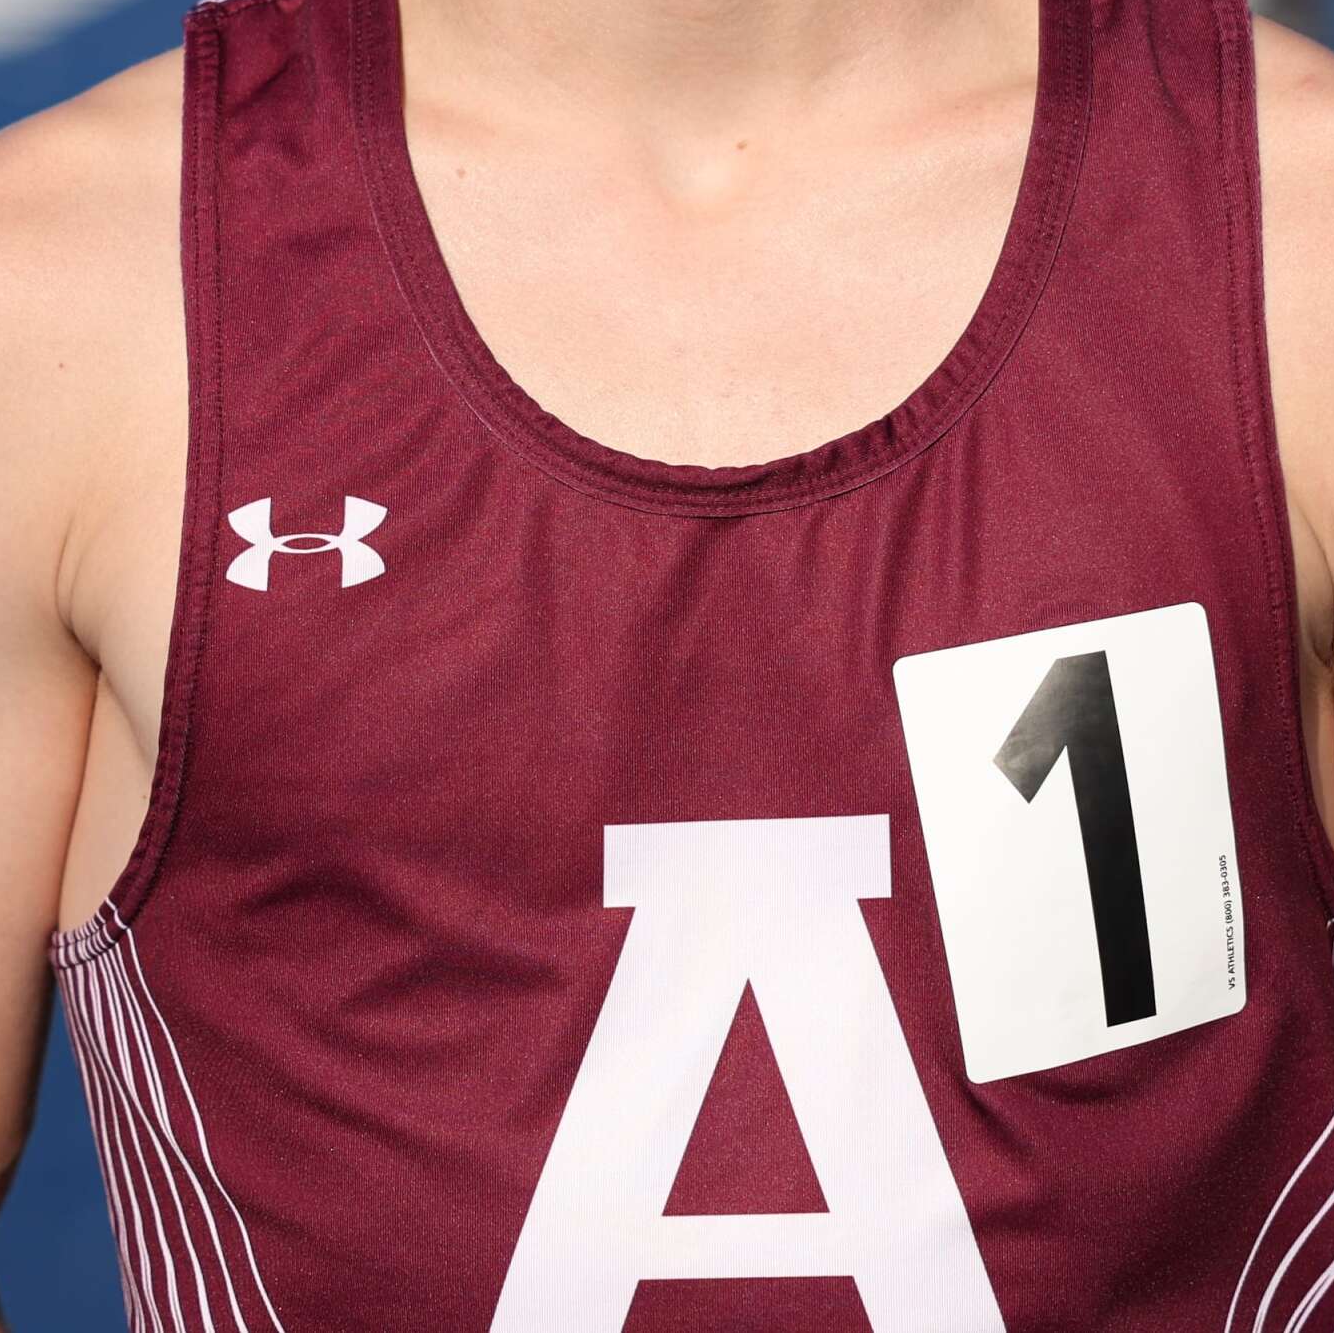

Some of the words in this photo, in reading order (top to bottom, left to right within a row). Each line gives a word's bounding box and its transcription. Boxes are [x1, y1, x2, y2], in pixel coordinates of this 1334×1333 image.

[993, 650, 1157, 1028] 1
[1219, 854, 1231, 898] 383-0305
[1223, 900, 1234, 924] (800)
[1226, 926, 1235, 974] ATHLETICS
[1228, 977, 1236, 990] VS
[488, 813, 1007, 1333] A
